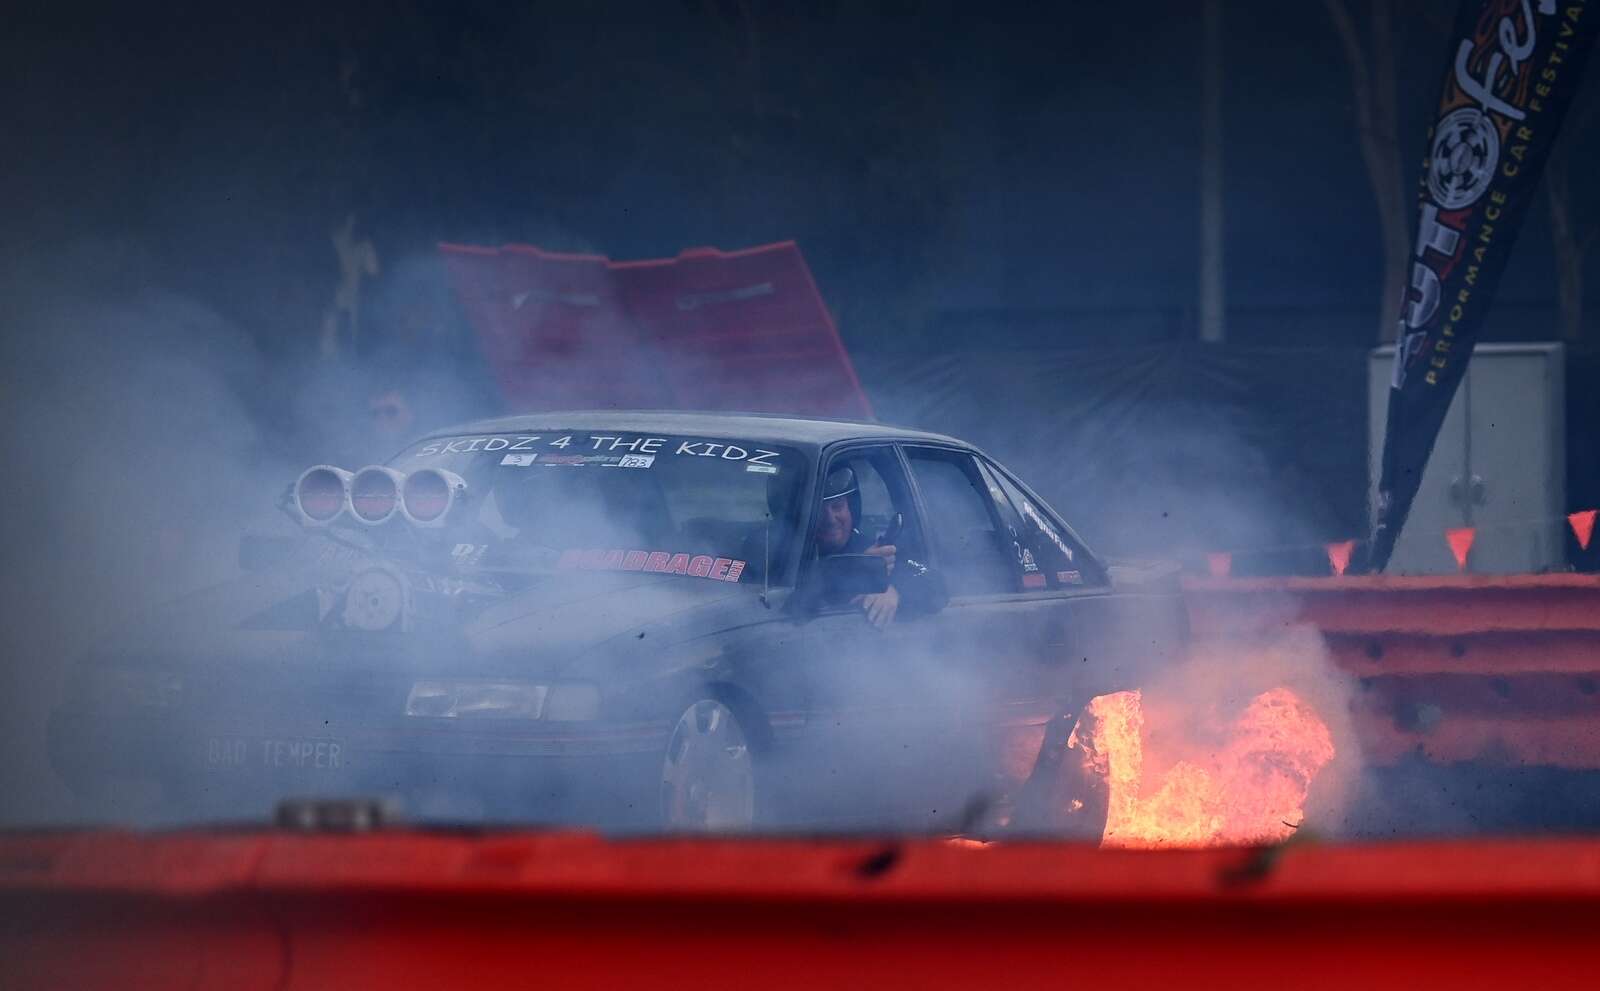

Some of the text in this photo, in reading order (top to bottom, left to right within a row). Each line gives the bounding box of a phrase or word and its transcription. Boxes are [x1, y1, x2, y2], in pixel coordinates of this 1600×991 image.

[1425, 0, 1588, 386] PERFORMANCE CAR FESTIVA
[416, 435, 781, 466] SKIDZ 4 THE KIDZ
[208, 737, 341, 769] BAD TEMPER
